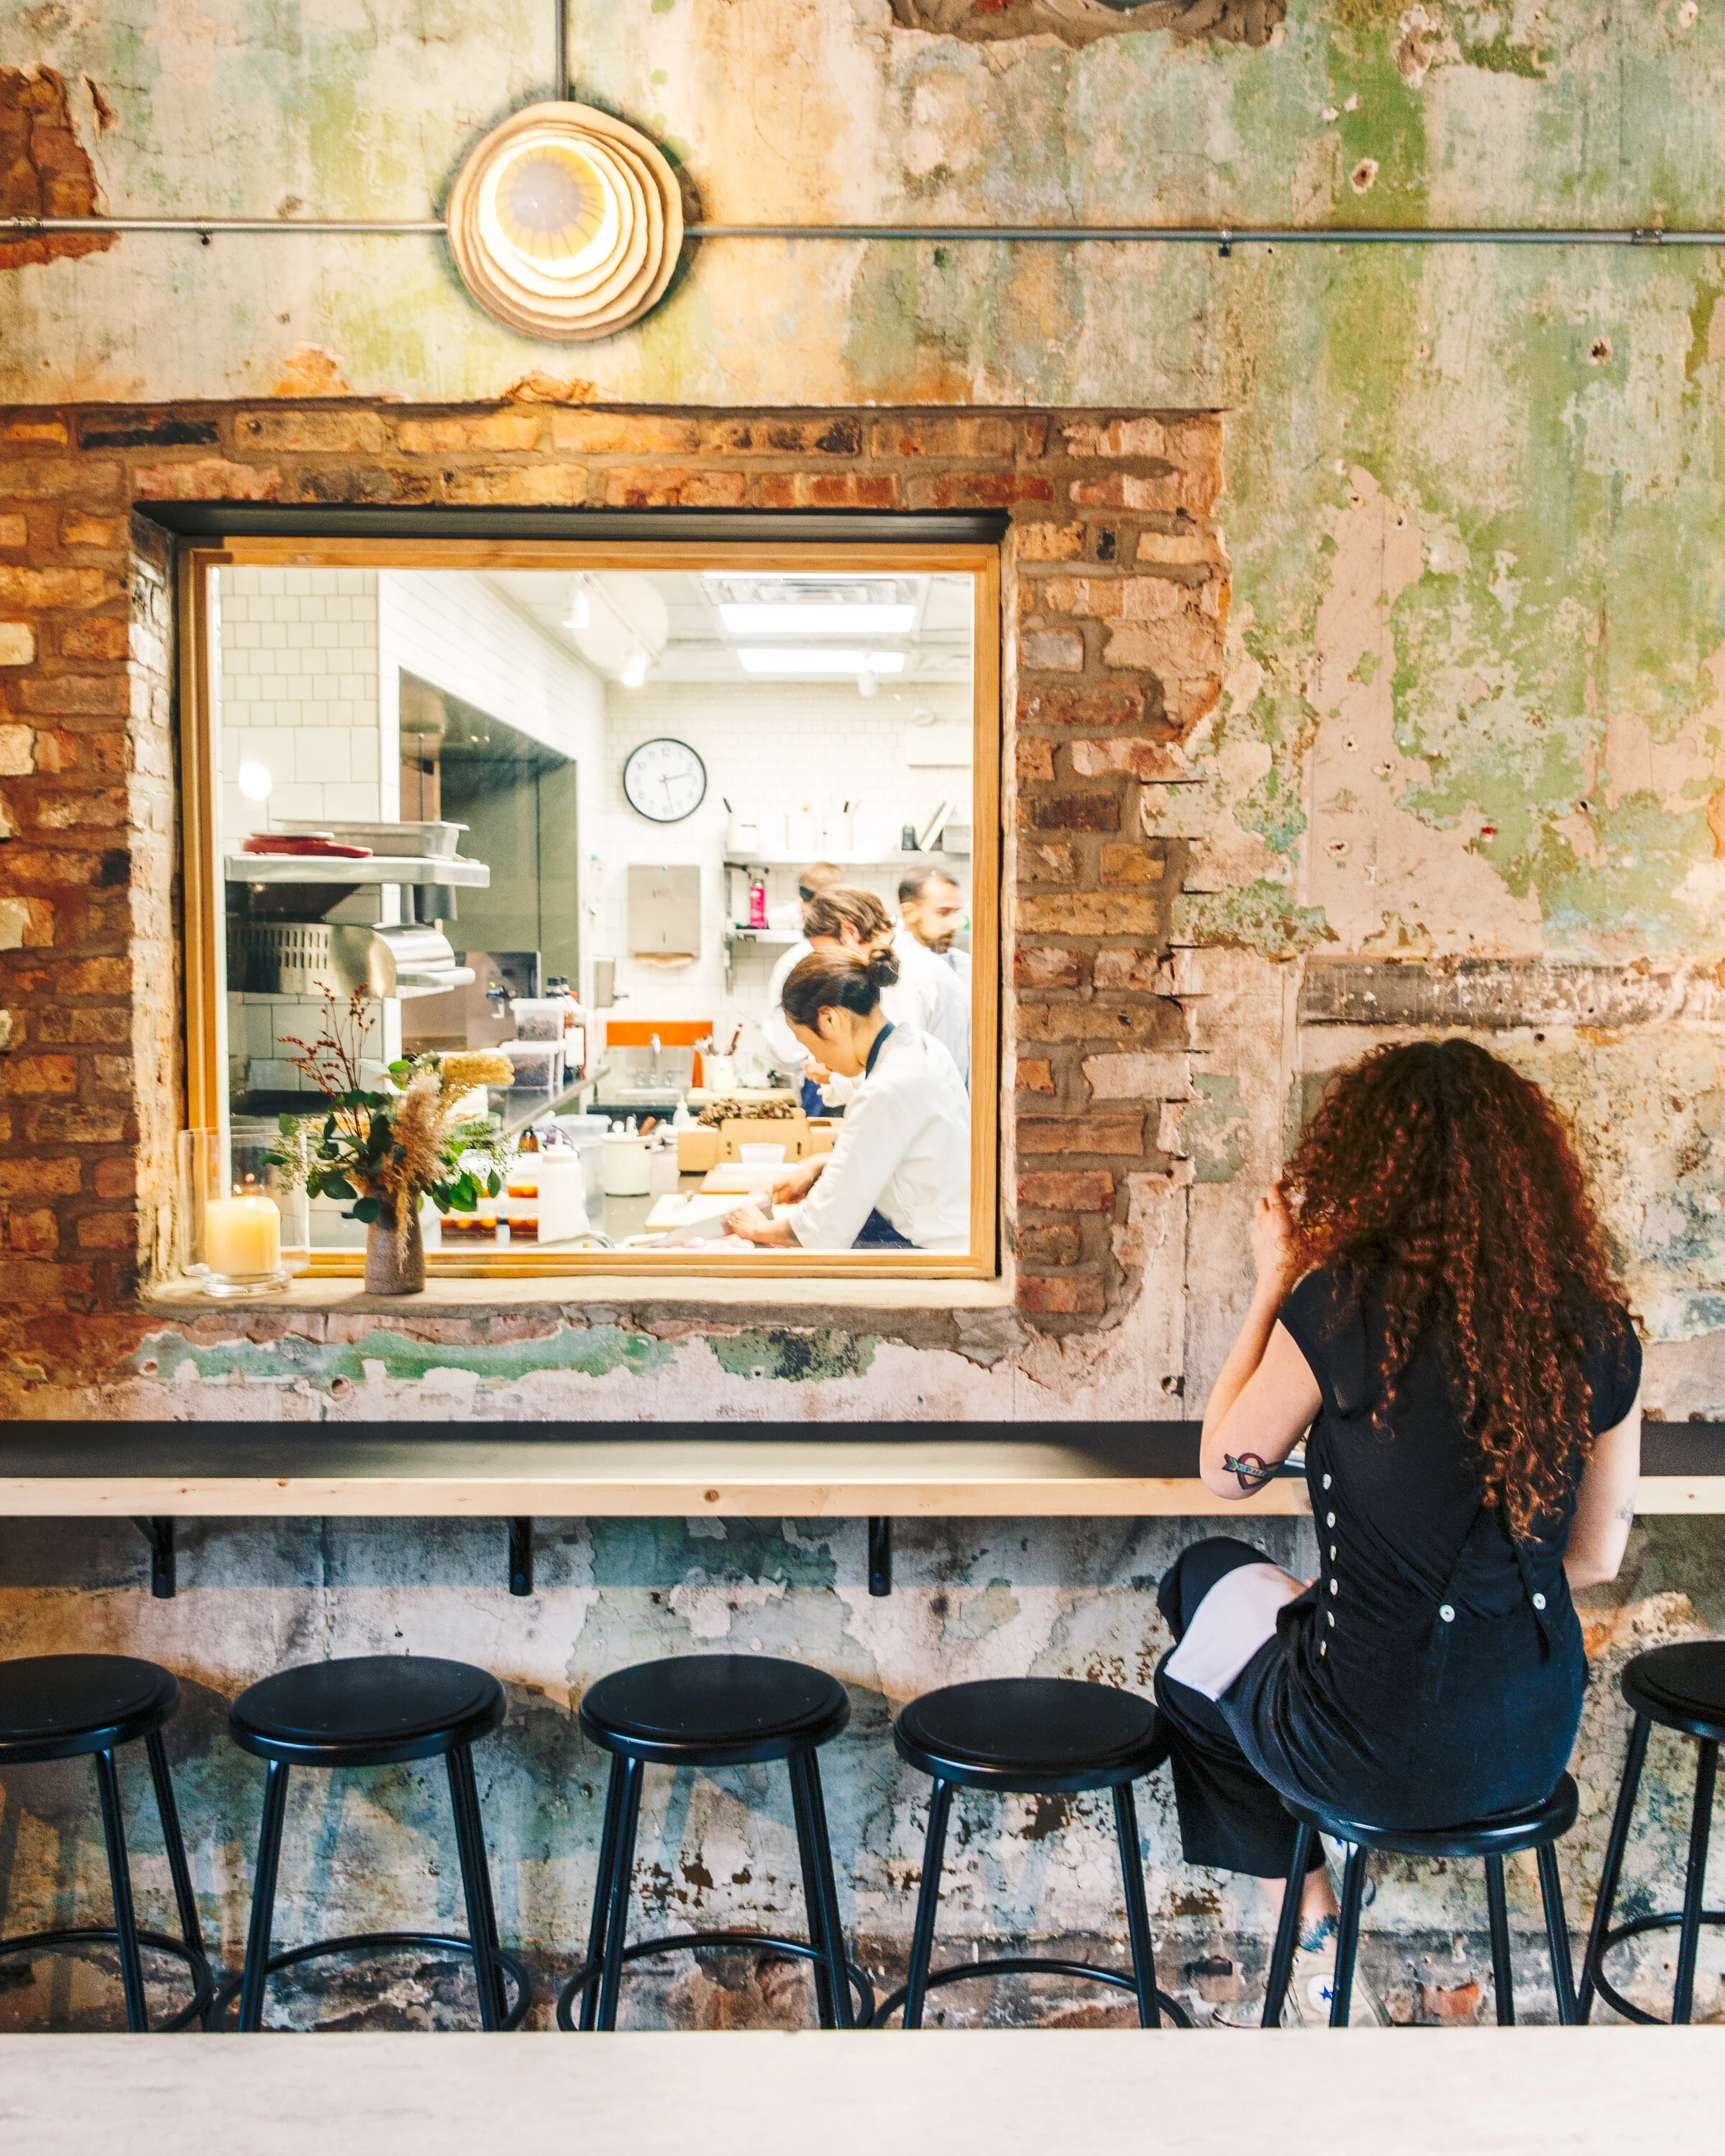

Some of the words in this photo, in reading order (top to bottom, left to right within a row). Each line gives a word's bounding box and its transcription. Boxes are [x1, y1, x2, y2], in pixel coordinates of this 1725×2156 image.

[648, 751, 656, 761] 11
[661, 747, 671, 757] 12
[636, 761, 647, 771] 10
[690, 775, 697, 786] 3
[662, 804, 669, 814] 6
